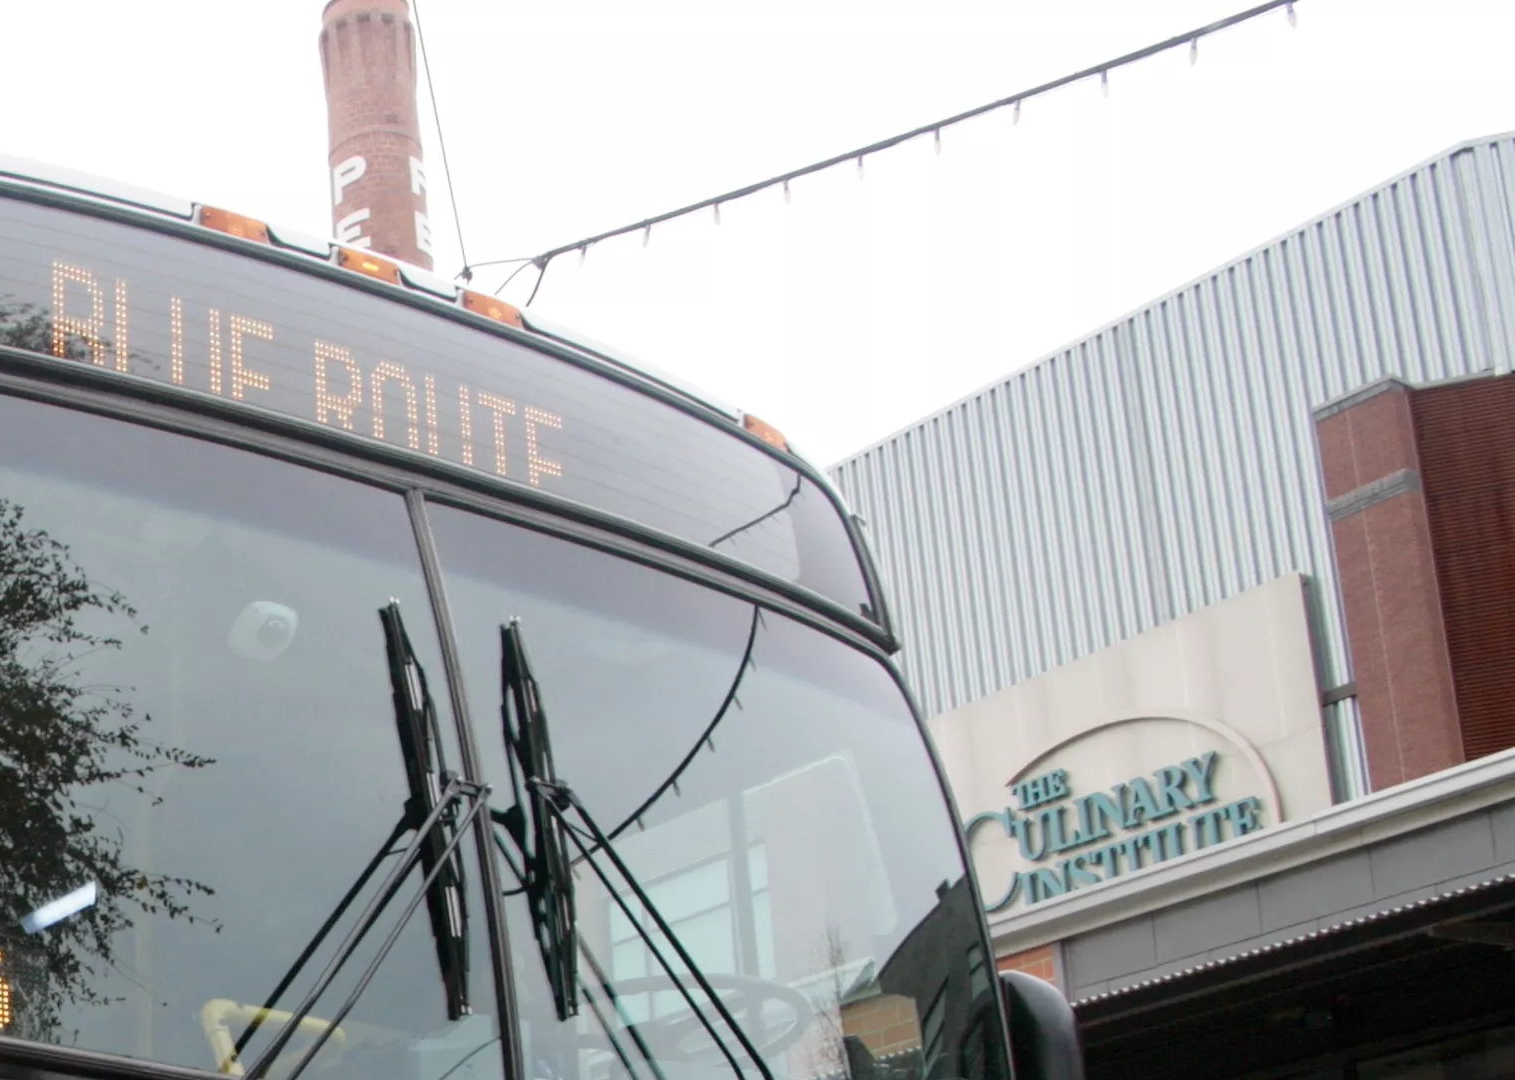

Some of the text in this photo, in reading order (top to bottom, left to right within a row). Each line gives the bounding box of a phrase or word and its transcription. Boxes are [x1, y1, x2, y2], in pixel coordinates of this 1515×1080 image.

[52, 258, 563, 487] BLUE ROUTE
[965, 750, 1218, 912] CULINARY
[1011, 768, 1070, 811] THE
[1019, 796, 1263, 905] INSTITUTE
